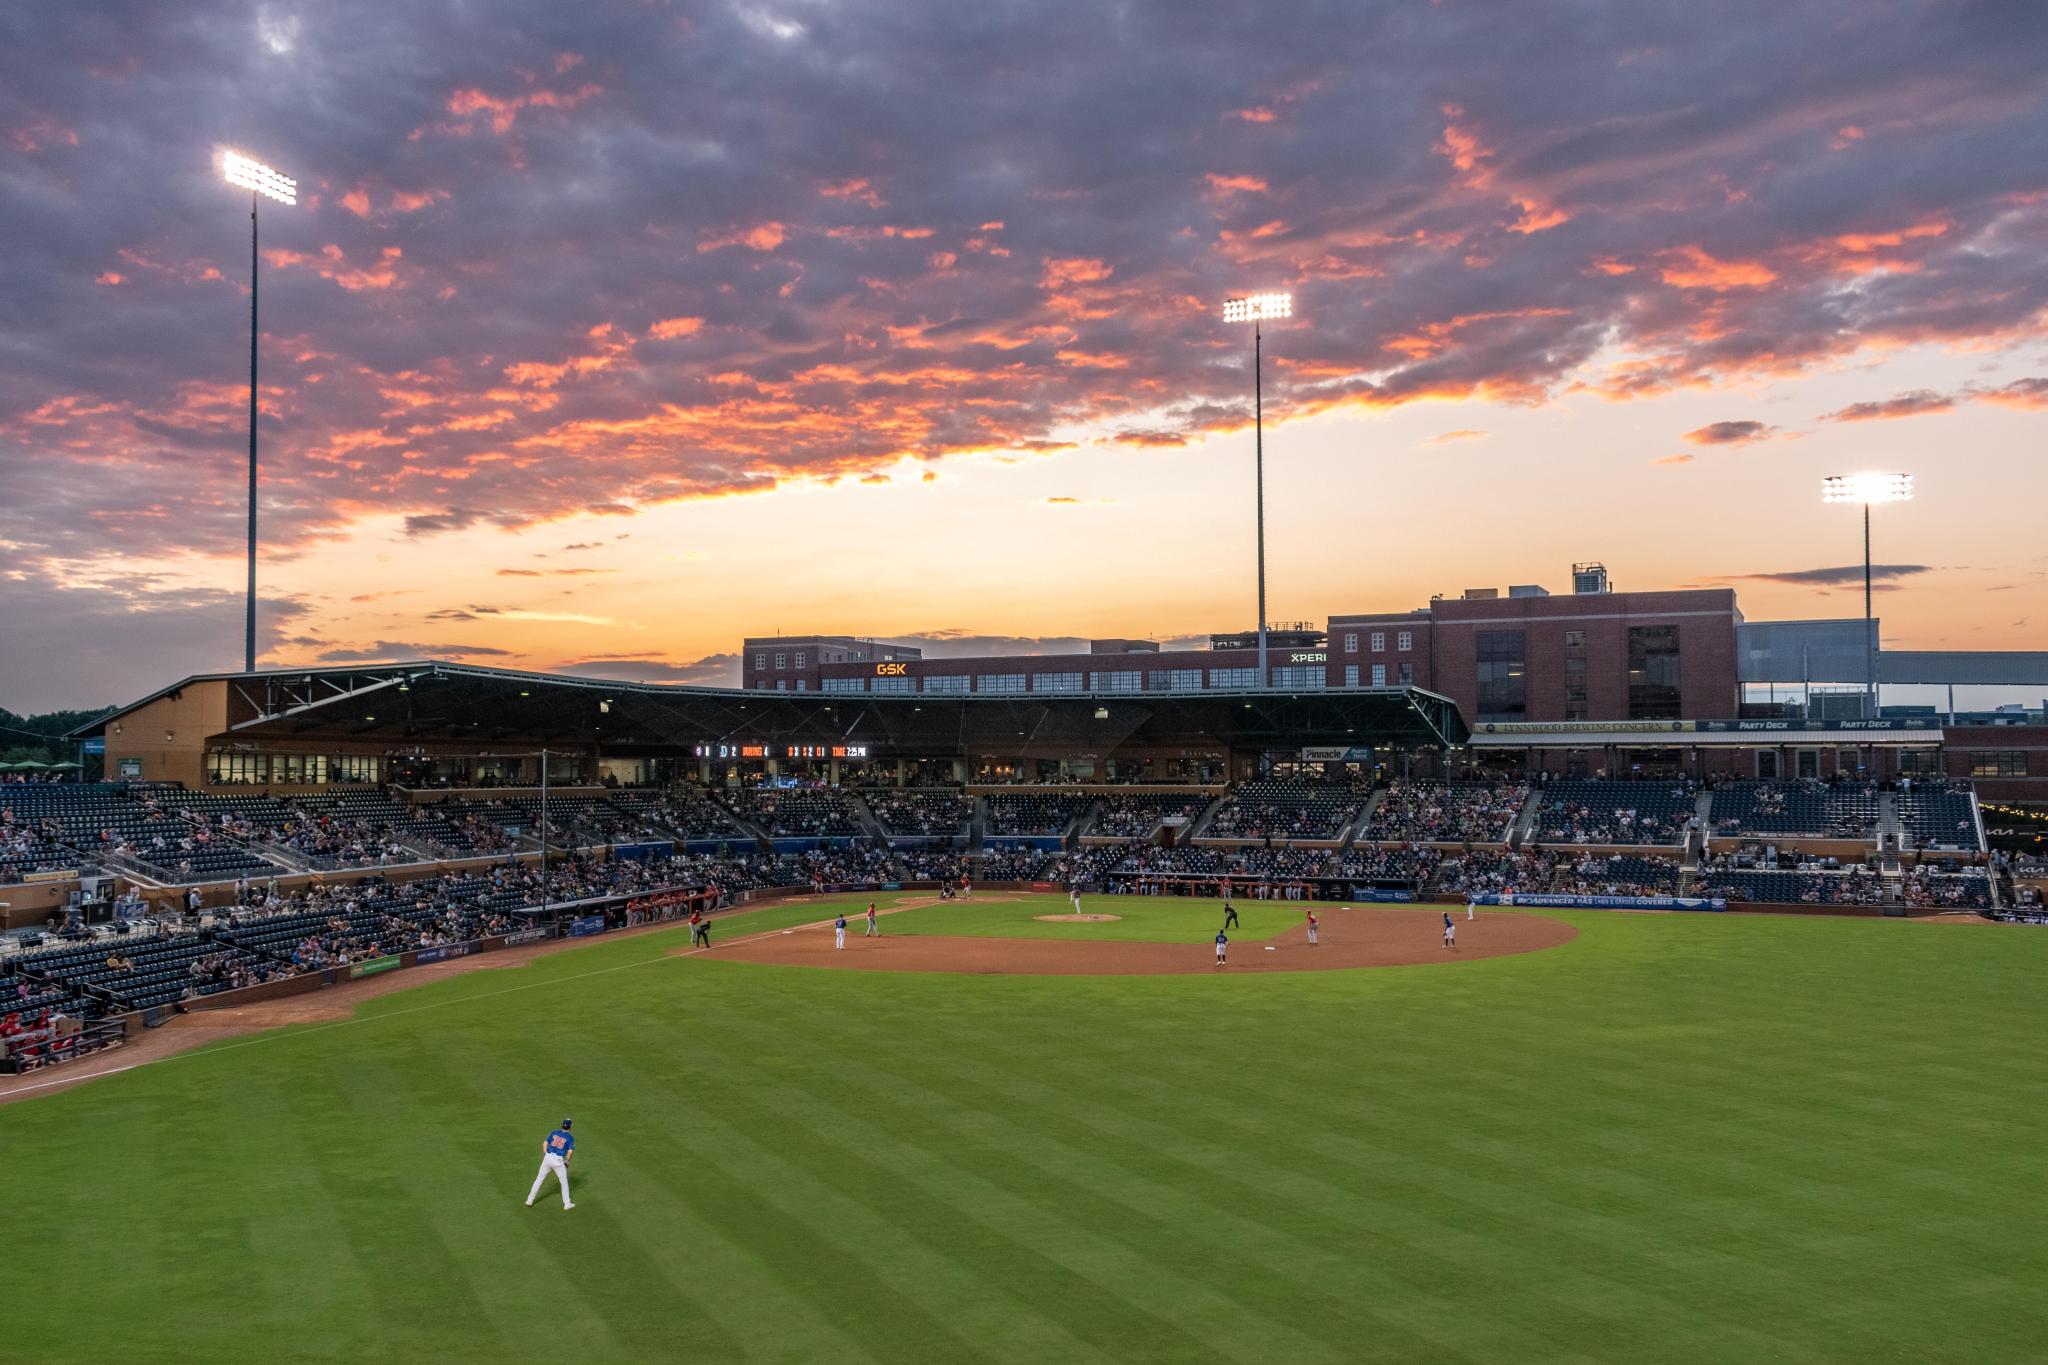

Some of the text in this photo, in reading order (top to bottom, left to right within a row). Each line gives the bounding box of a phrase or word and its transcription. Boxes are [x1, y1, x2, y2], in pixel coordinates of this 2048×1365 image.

[1291, 653, 1327, 662] XPERI
[877, 663, 906, 675] GSK
[1504, 722, 1663, 732] LYNNWOOD BREWING CONCERN
[1766, 721, 1788, 729] DECK
[1867, 720, 1892, 728] DECK
[731, 746, 737, 757] 2
[742, 746, 769, 757] INNING 4
[832, 746, 846, 757] TIME
[858, 746, 866, 757] PM
[1305, 749, 1341, 759] Pinnacle
